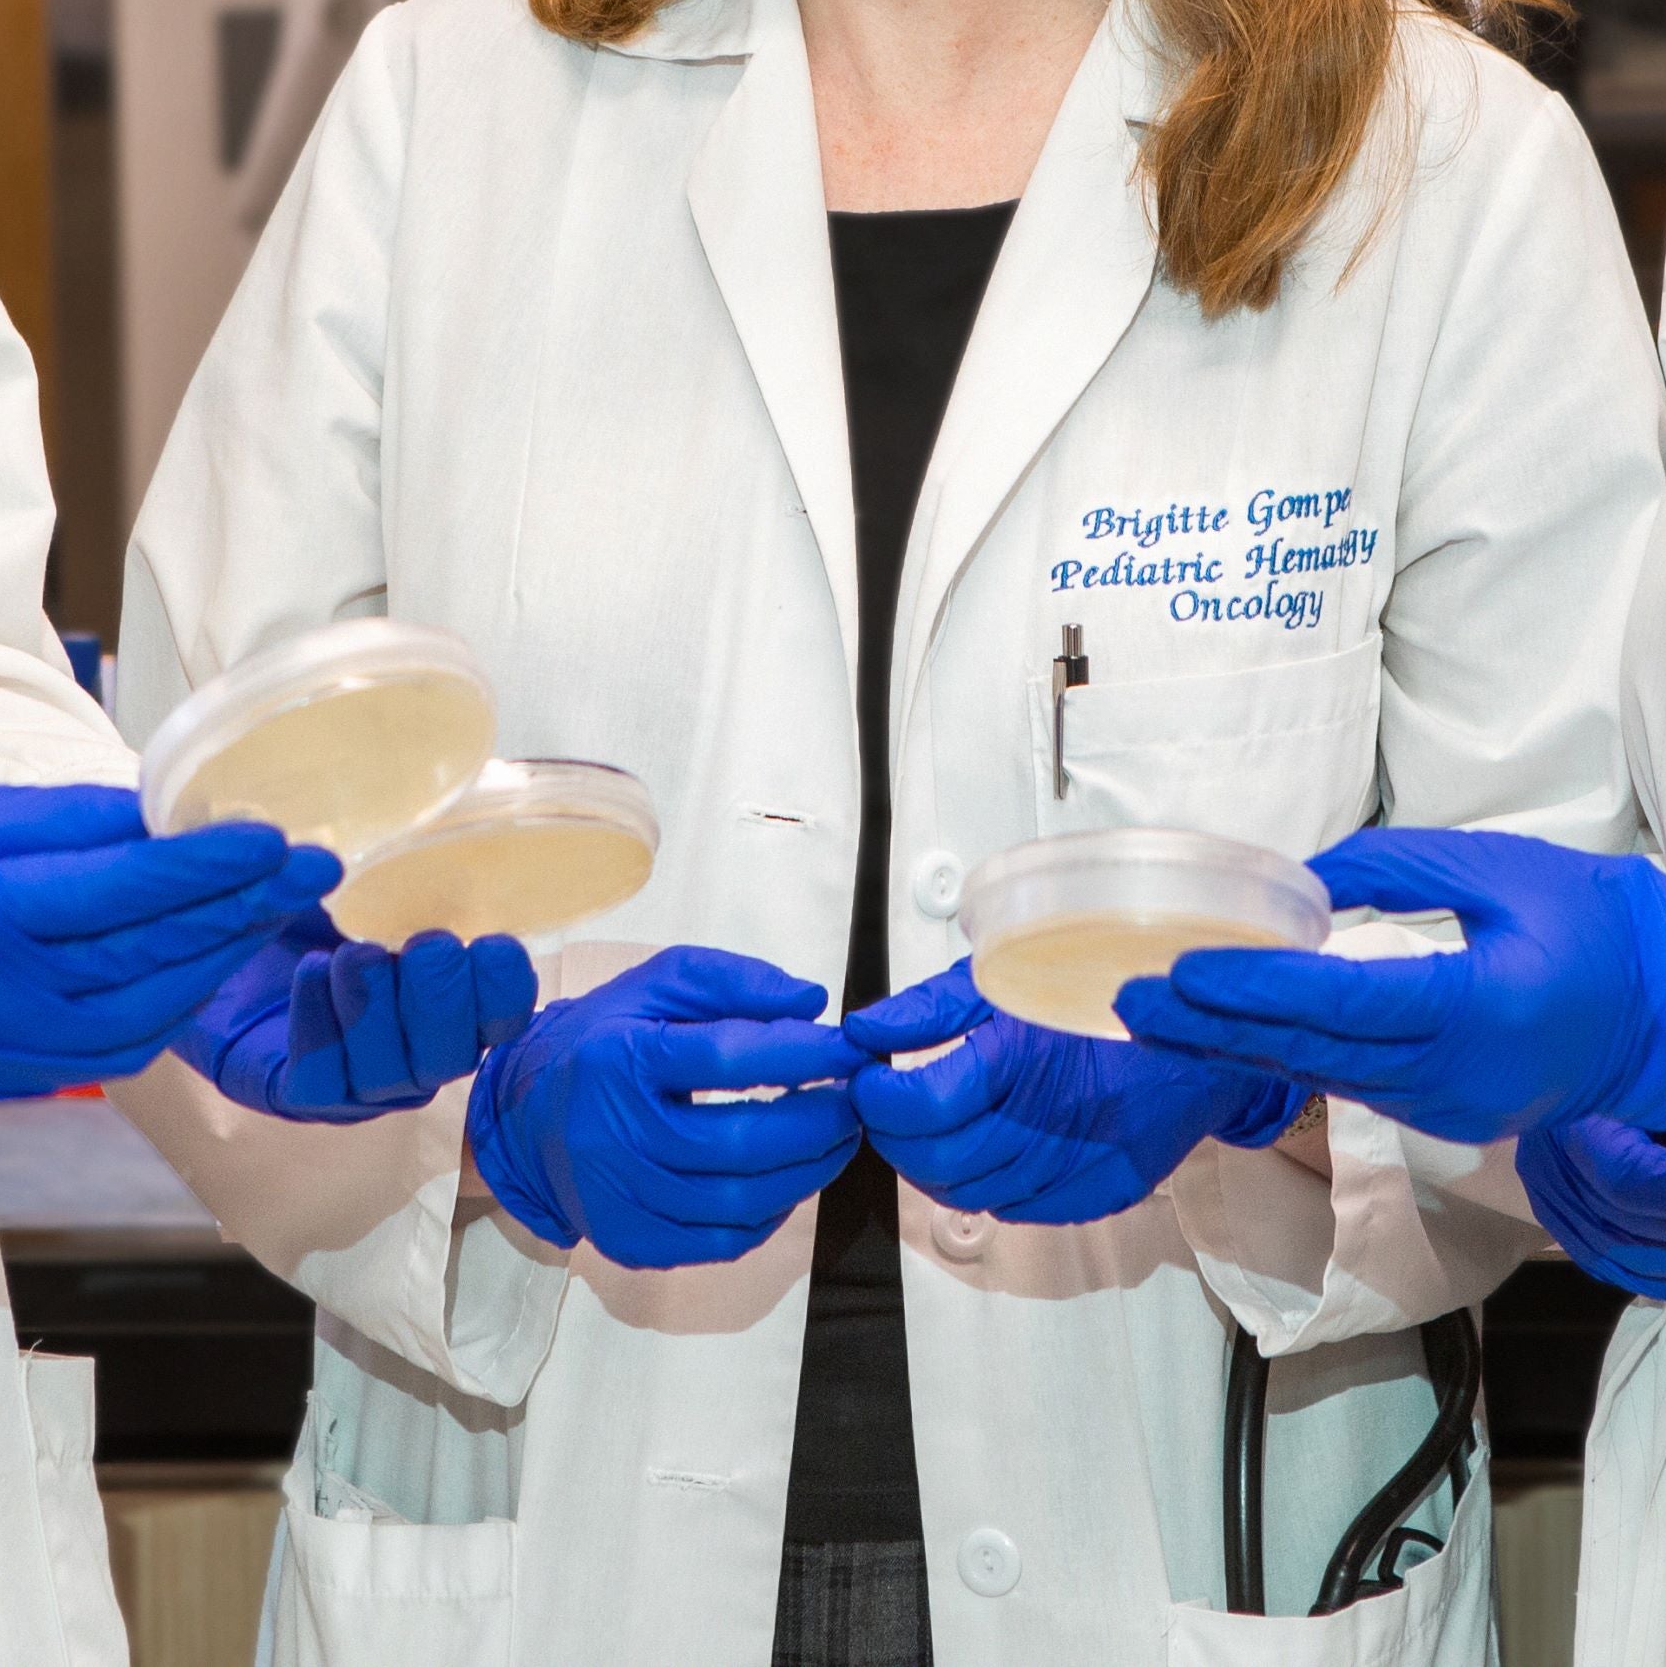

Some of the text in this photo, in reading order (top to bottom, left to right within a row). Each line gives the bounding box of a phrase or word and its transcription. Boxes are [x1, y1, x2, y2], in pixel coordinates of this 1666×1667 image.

[1082, 503, 1229, 548] Brigitte
[1051, 551, 1223, 593] Pediatric
[1170, 579, 1324, 630] Oncology
